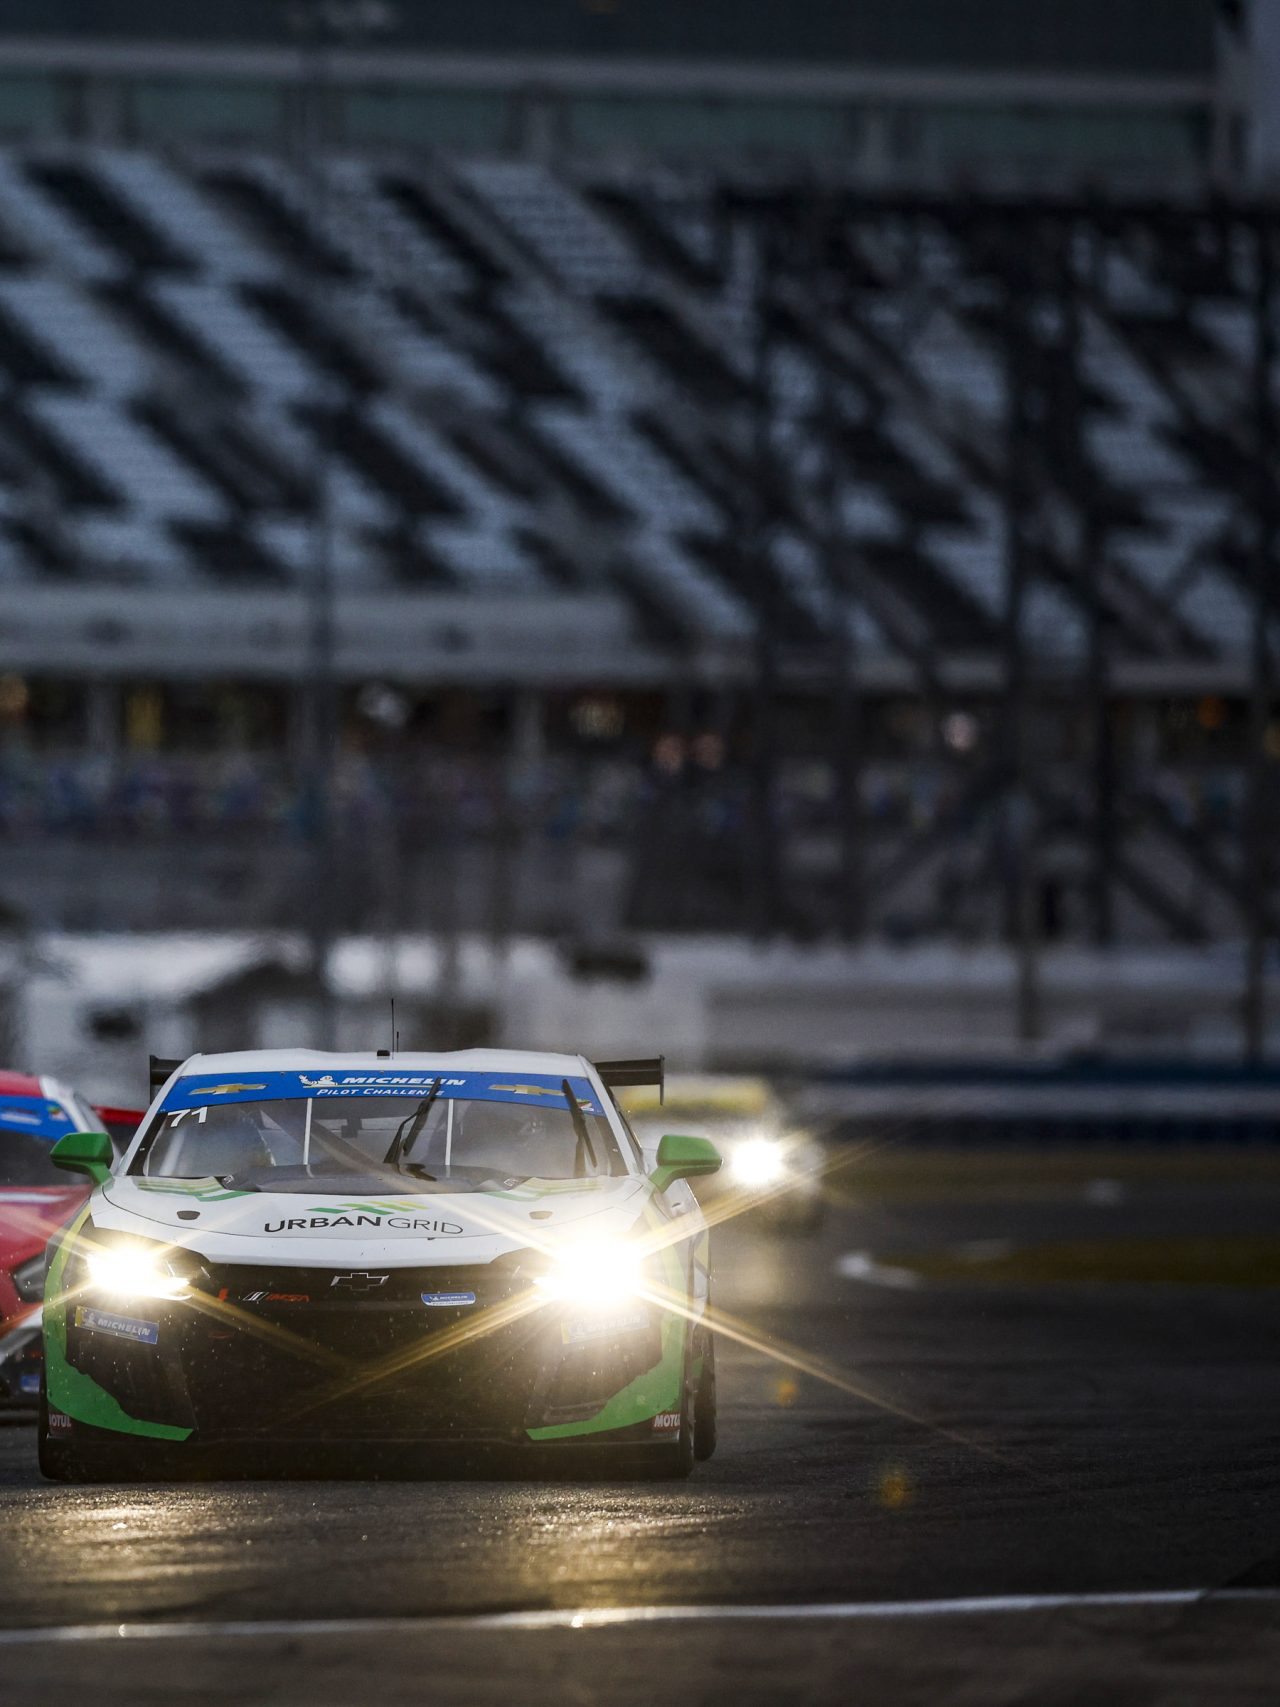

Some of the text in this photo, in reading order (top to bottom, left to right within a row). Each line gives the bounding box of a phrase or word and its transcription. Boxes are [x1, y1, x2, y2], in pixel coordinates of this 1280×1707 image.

[342, 1077, 466, 1086] MICHELIN
[316, 1088, 445, 1096] PILOT CHALLENE
[168, 1106, 208, 1128] 71
[97, 1318, 151, 1336] MICHELIN
